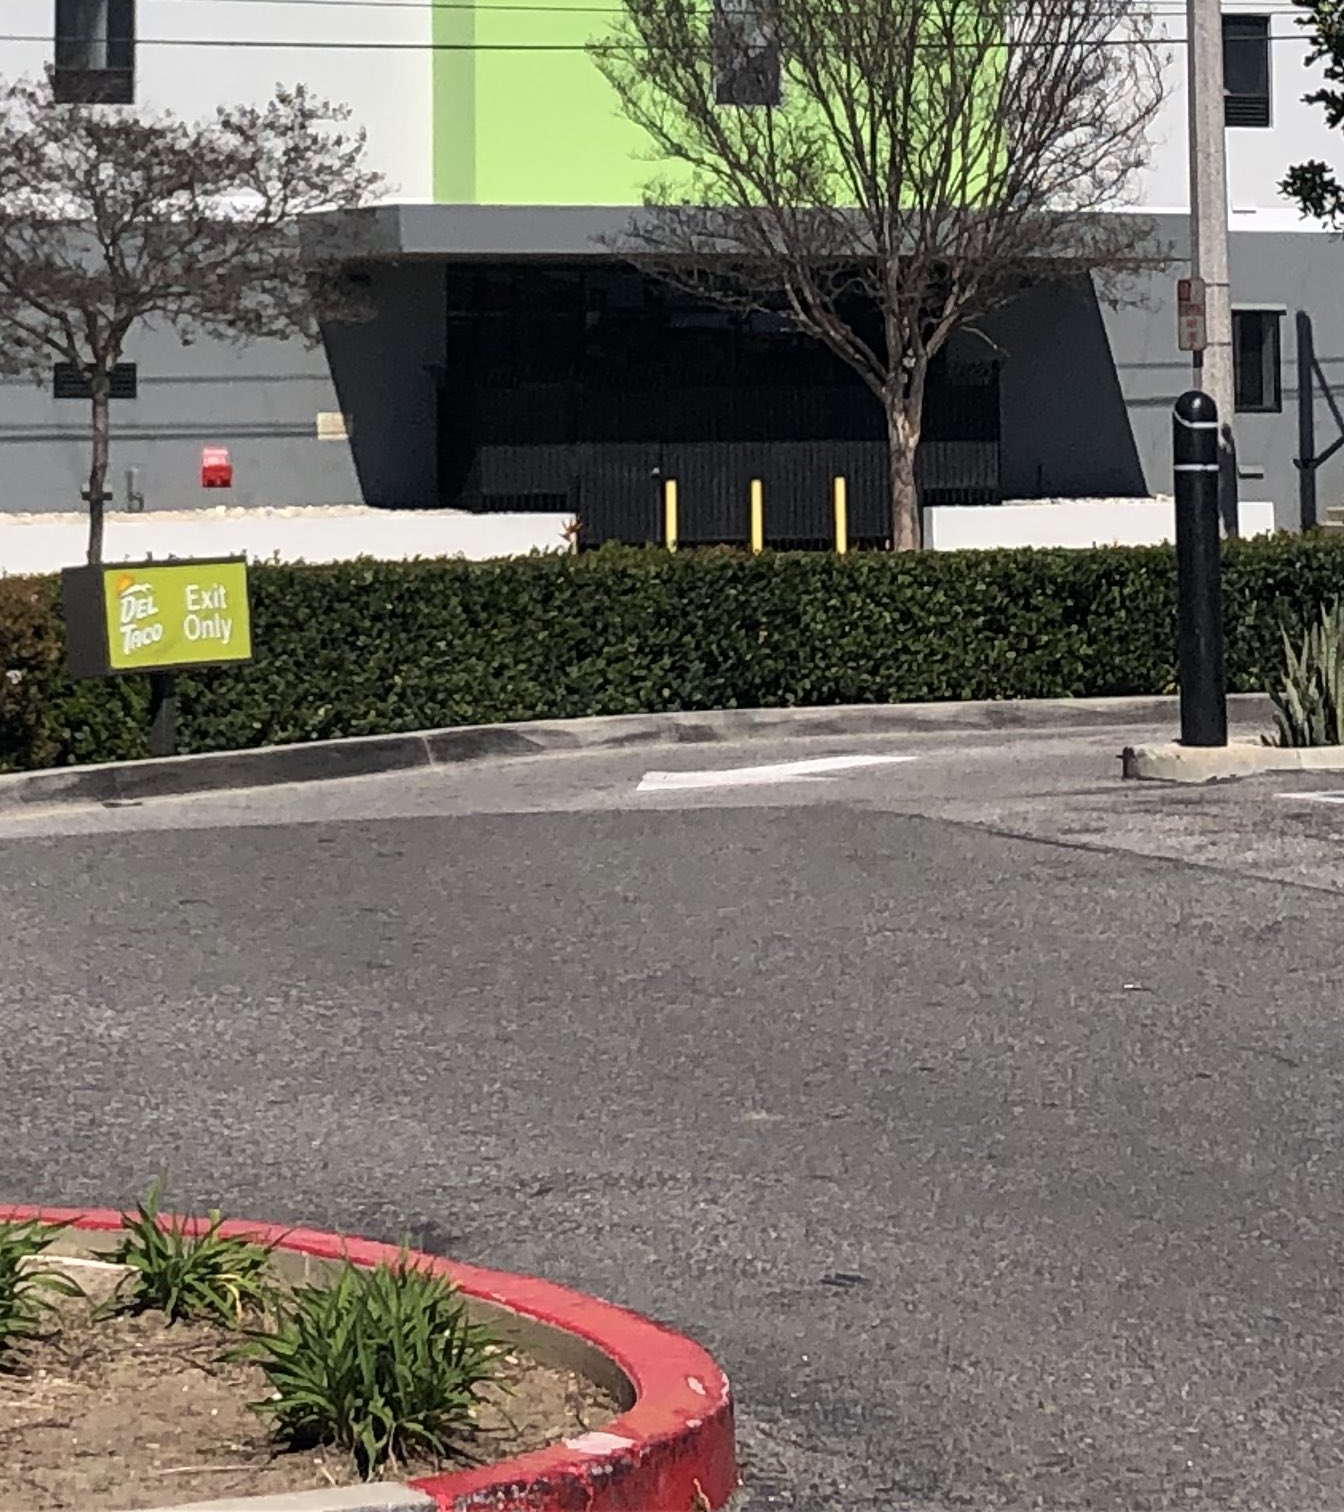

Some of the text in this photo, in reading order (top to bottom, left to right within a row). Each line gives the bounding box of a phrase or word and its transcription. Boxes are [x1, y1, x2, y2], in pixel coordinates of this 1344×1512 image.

[120, 595, 159, 623] DEL
[185, 584, 228, 611] Exit
[120, 623, 163, 655] TACO
[183, 613, 233, 644] Only
